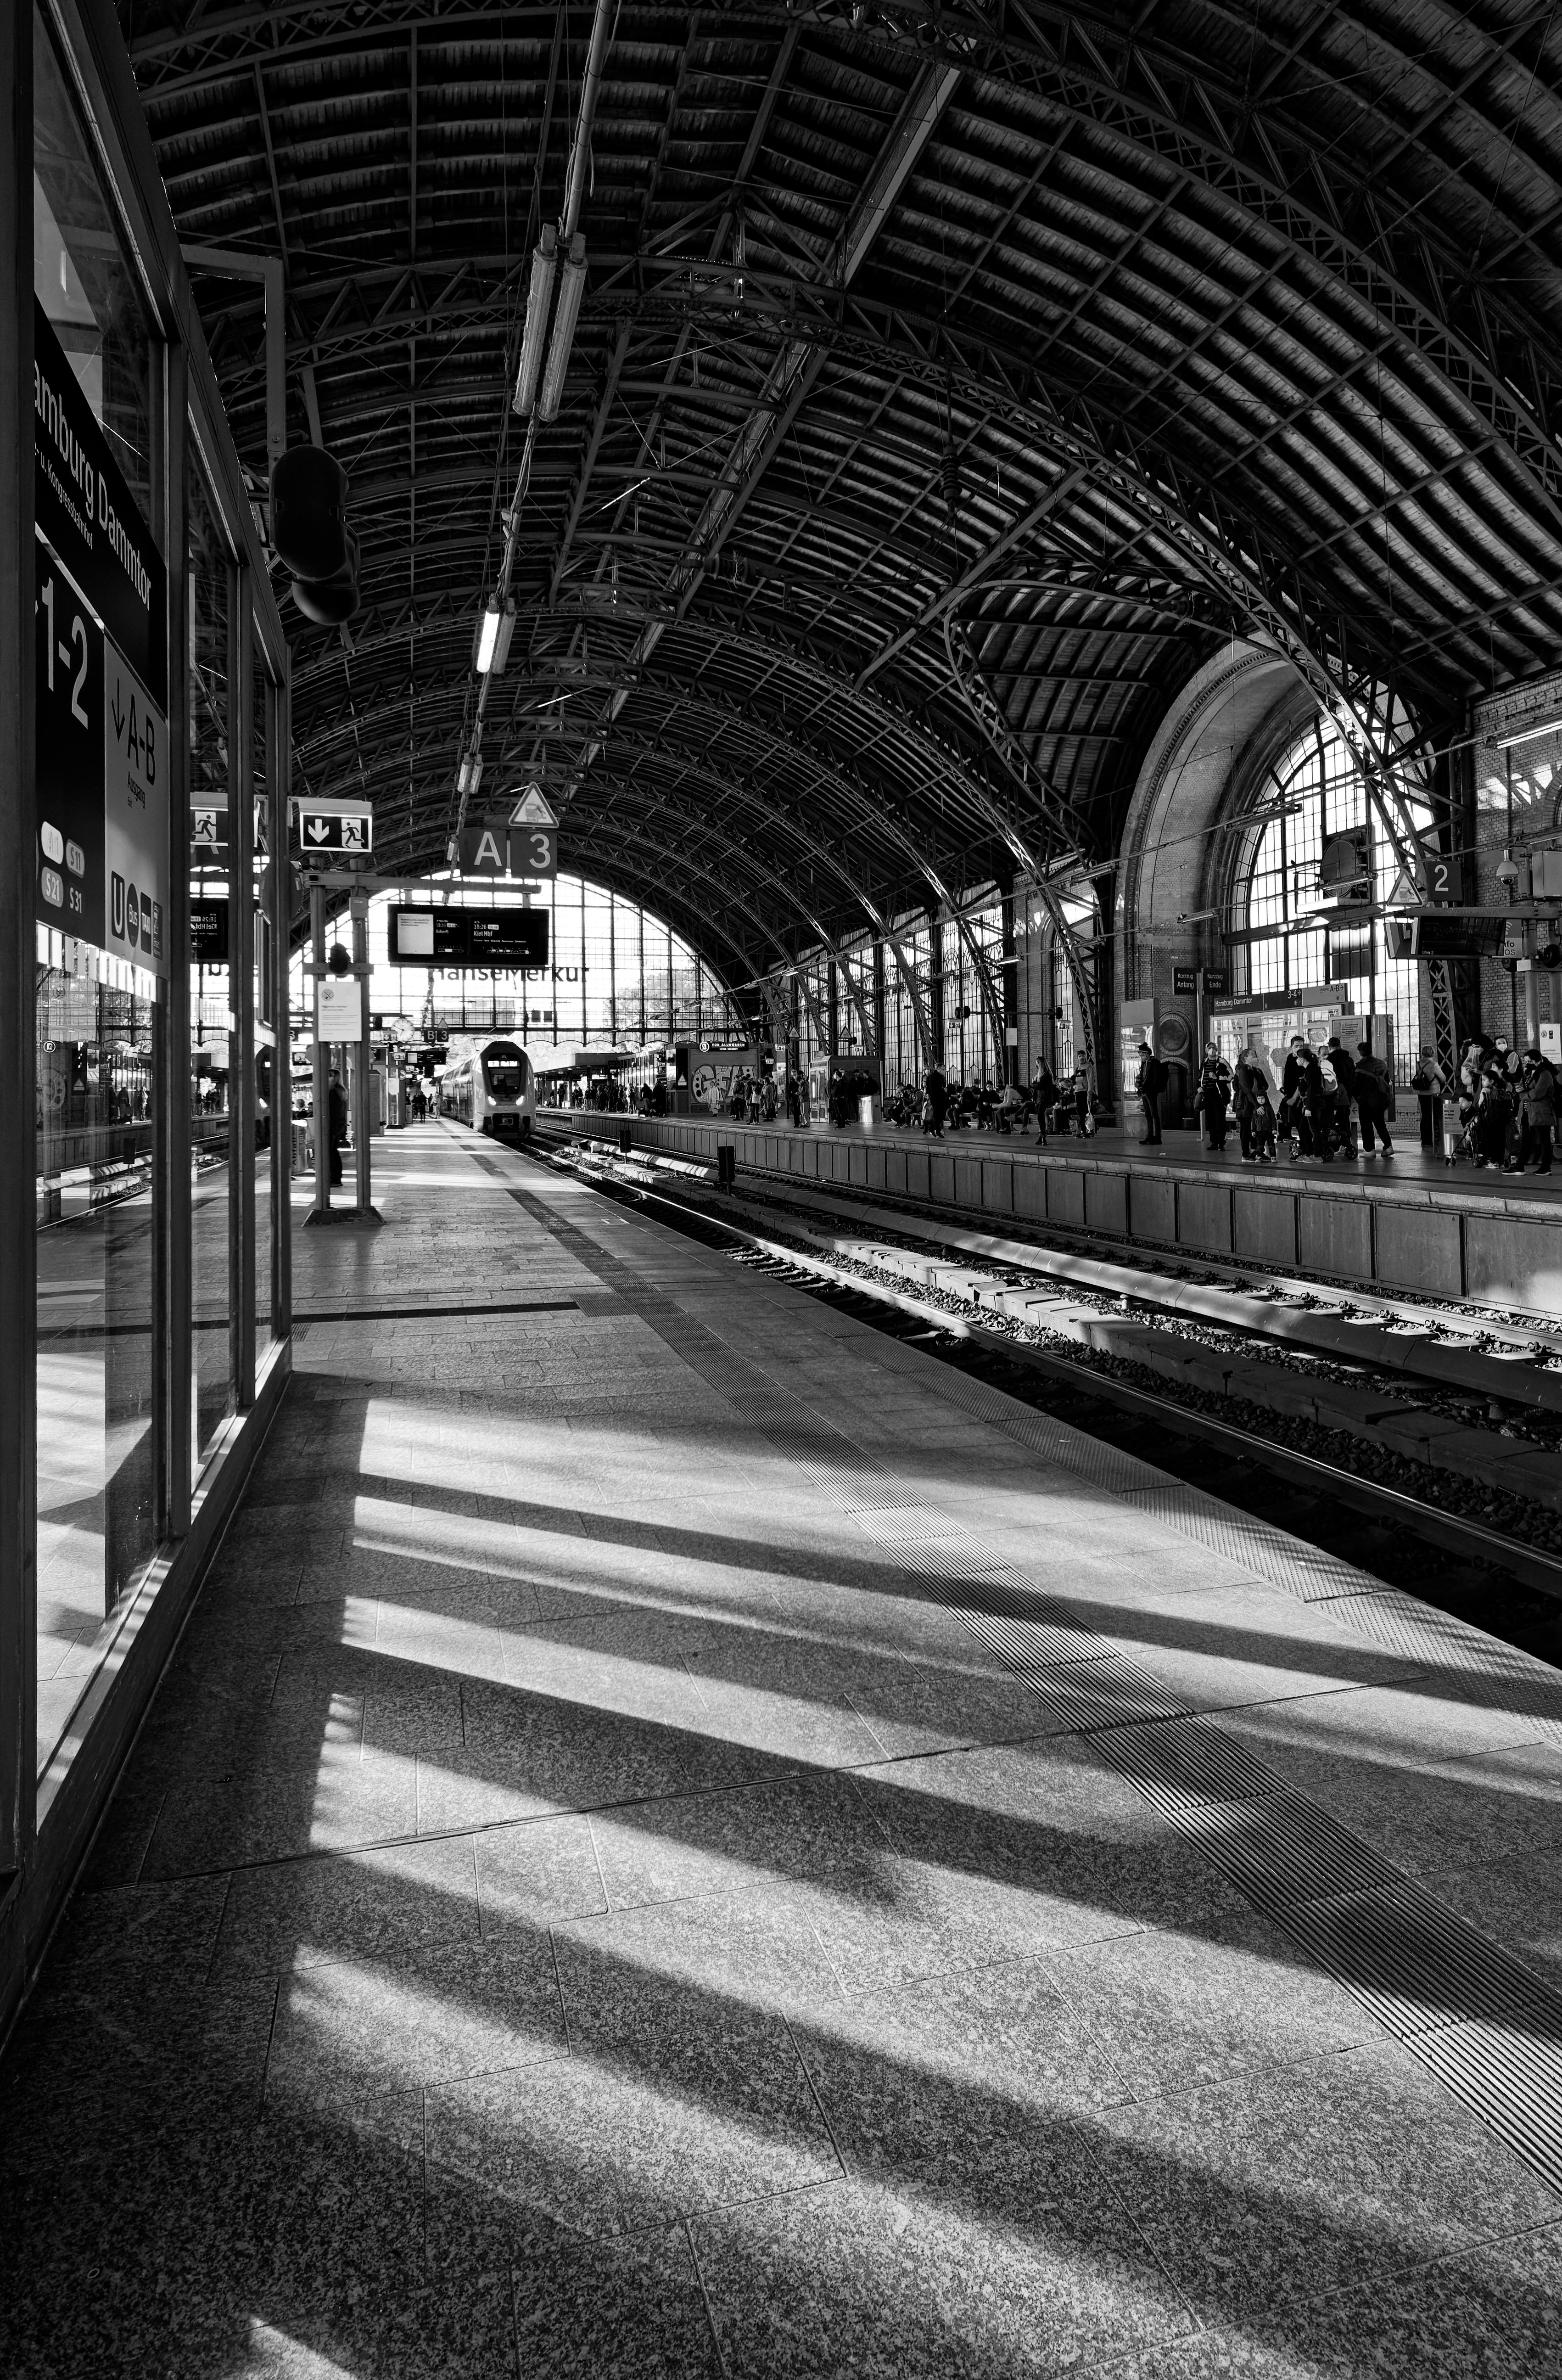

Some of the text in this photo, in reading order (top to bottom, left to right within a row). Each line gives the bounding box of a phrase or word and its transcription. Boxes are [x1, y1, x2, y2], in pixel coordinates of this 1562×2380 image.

[48, 459, 92, 550] Kongressbahnhof
[99, 471, 151, 610] Dammtor
[42, 577, 88, 730] 1-2
[127, 693, 155, 786] A-B
[128, 771, 145, 809] Ausgang
[474, 831, 502, 866] A
[529, 833, 551, 868] 3
[1434, 864, 1449, 892] 2
[114, 877, 123, 934] U
[1177, 981, 1194, 989] Anfang
[1288, 990, 1297, 999] 3-4
[427, 1030, 435, 1040] B
[441, 1031, 448, 1040] 3
